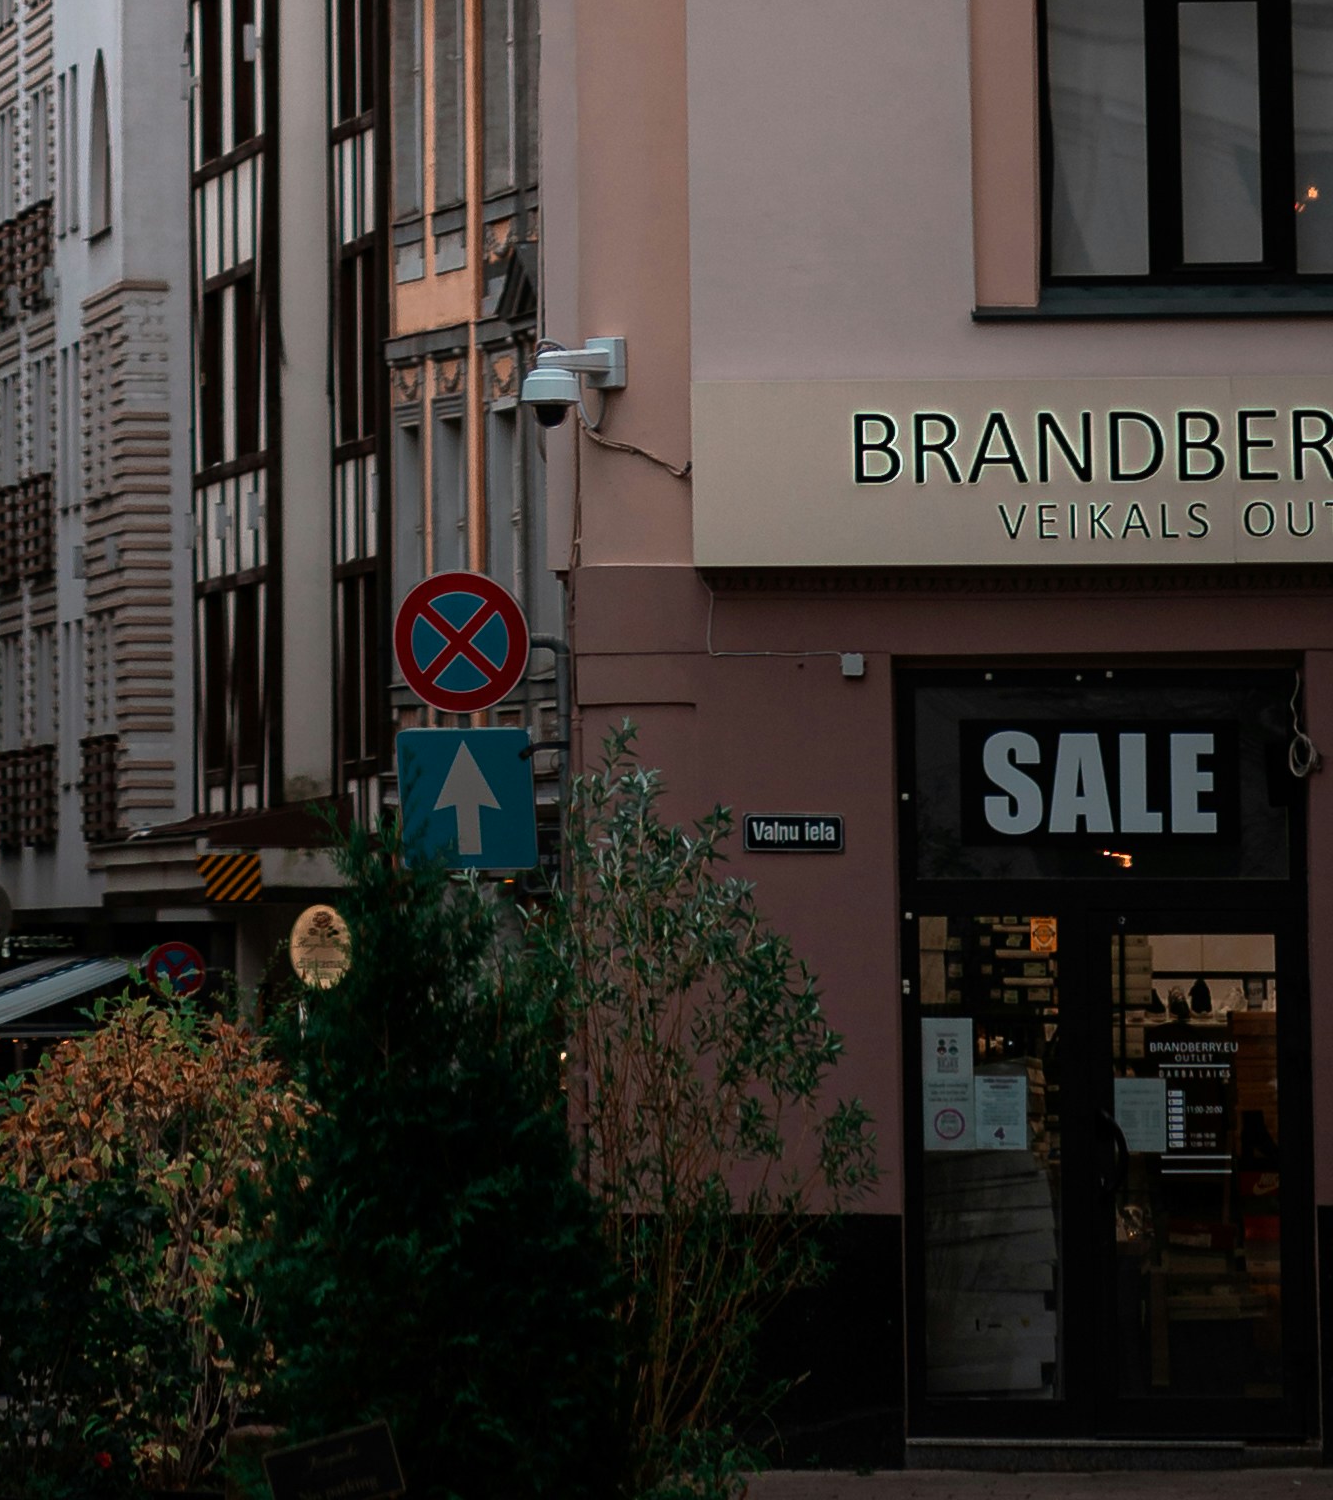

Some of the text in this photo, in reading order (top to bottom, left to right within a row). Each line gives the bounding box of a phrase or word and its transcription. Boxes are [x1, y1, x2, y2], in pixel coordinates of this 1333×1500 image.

[853, 409, 1333, 484] BRANDBER
[998, 502, 1211, 540] VEIKALS
[983, 730, 1218, 835] SALE
[804, 821, 835, 841] iela
[1149, 1041, 1239, 1053] BRANDBERRY.EU
[1174, 1053, 1213, 1062] OUTLET
